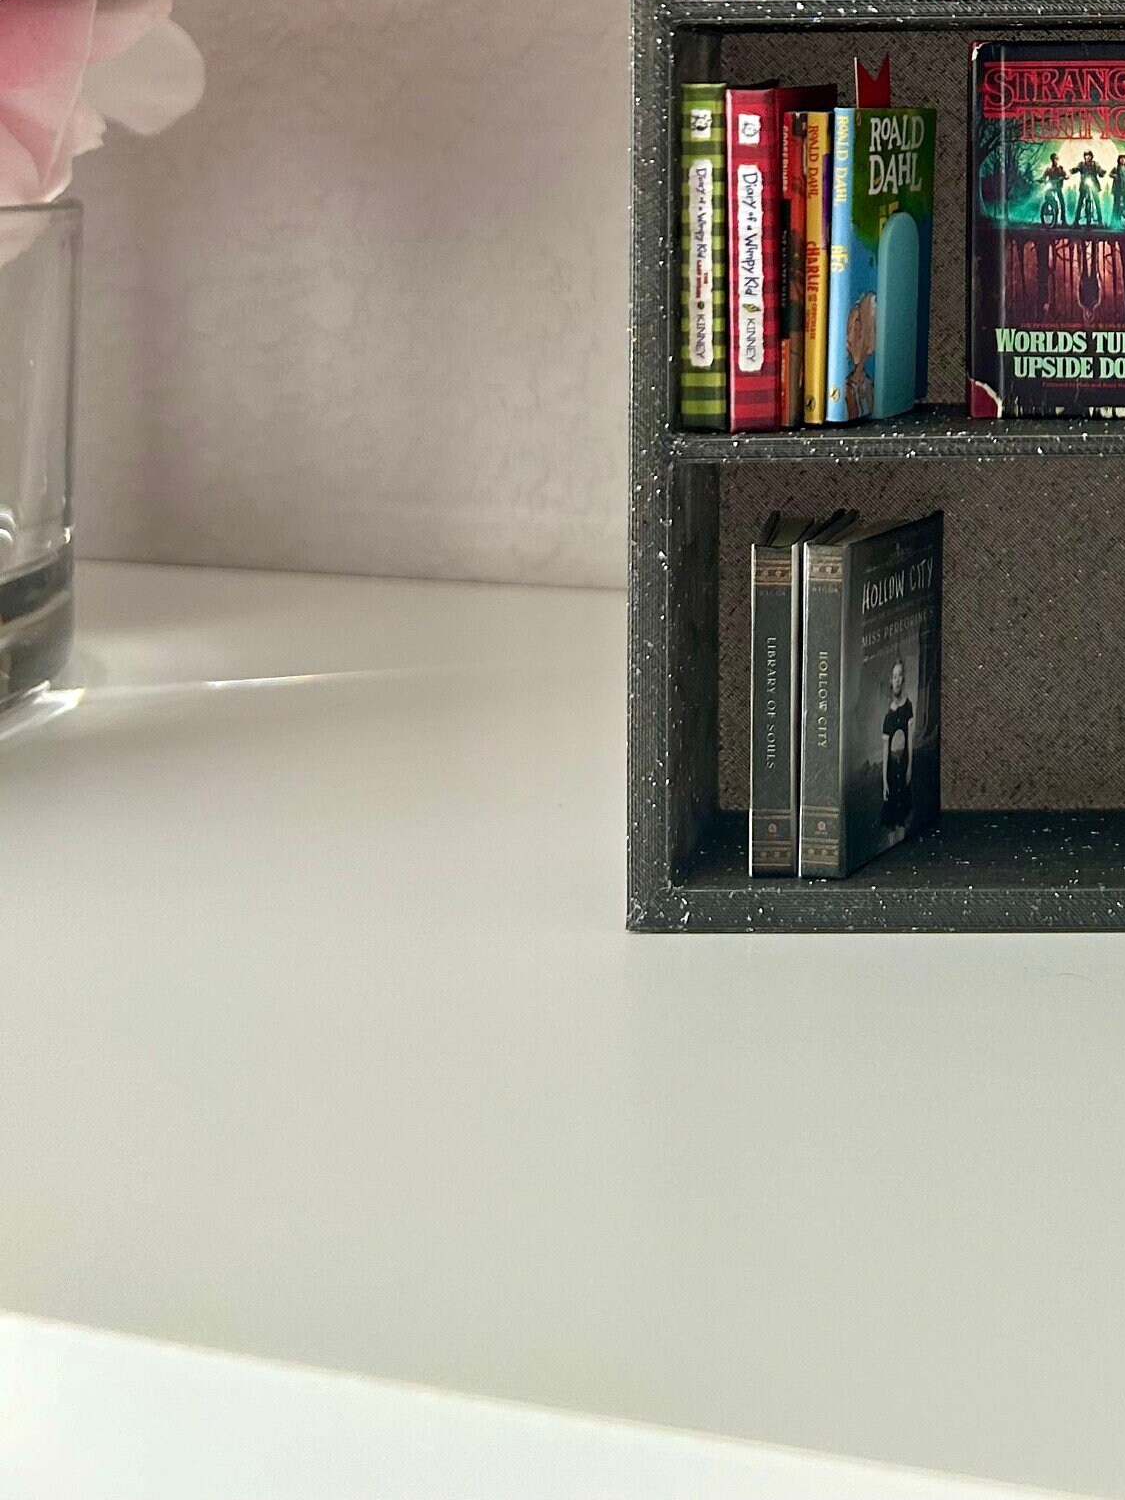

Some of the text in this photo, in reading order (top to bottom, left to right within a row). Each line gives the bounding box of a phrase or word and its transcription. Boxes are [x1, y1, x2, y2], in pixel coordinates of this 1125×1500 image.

[868, 113, 925, 153] ROALD
[806, 124, 819, 200] ROALD DAHL
[834, 115, 849, 206] ROALD DAHL
[867, 151, 923, 196] DAHL
[742, 172, 758, 209] Diary
[806, 241, 820, 292] CHARLIE
[696, 313, 706, 360] KINNEY
[744, 318, 757, 363] KINNEY
[994, 327, 1088, 353] WORLDS
[1013, 356, 1094, 379] UPSIDE
[862, 556, 934, 615] HOLLOW CITY
[862, 629, 881, 648] MISS
[766, 637, 777, 769] LIBRARY OF SOULS
[817, 651, 829, 748] HOLLOW CITY
